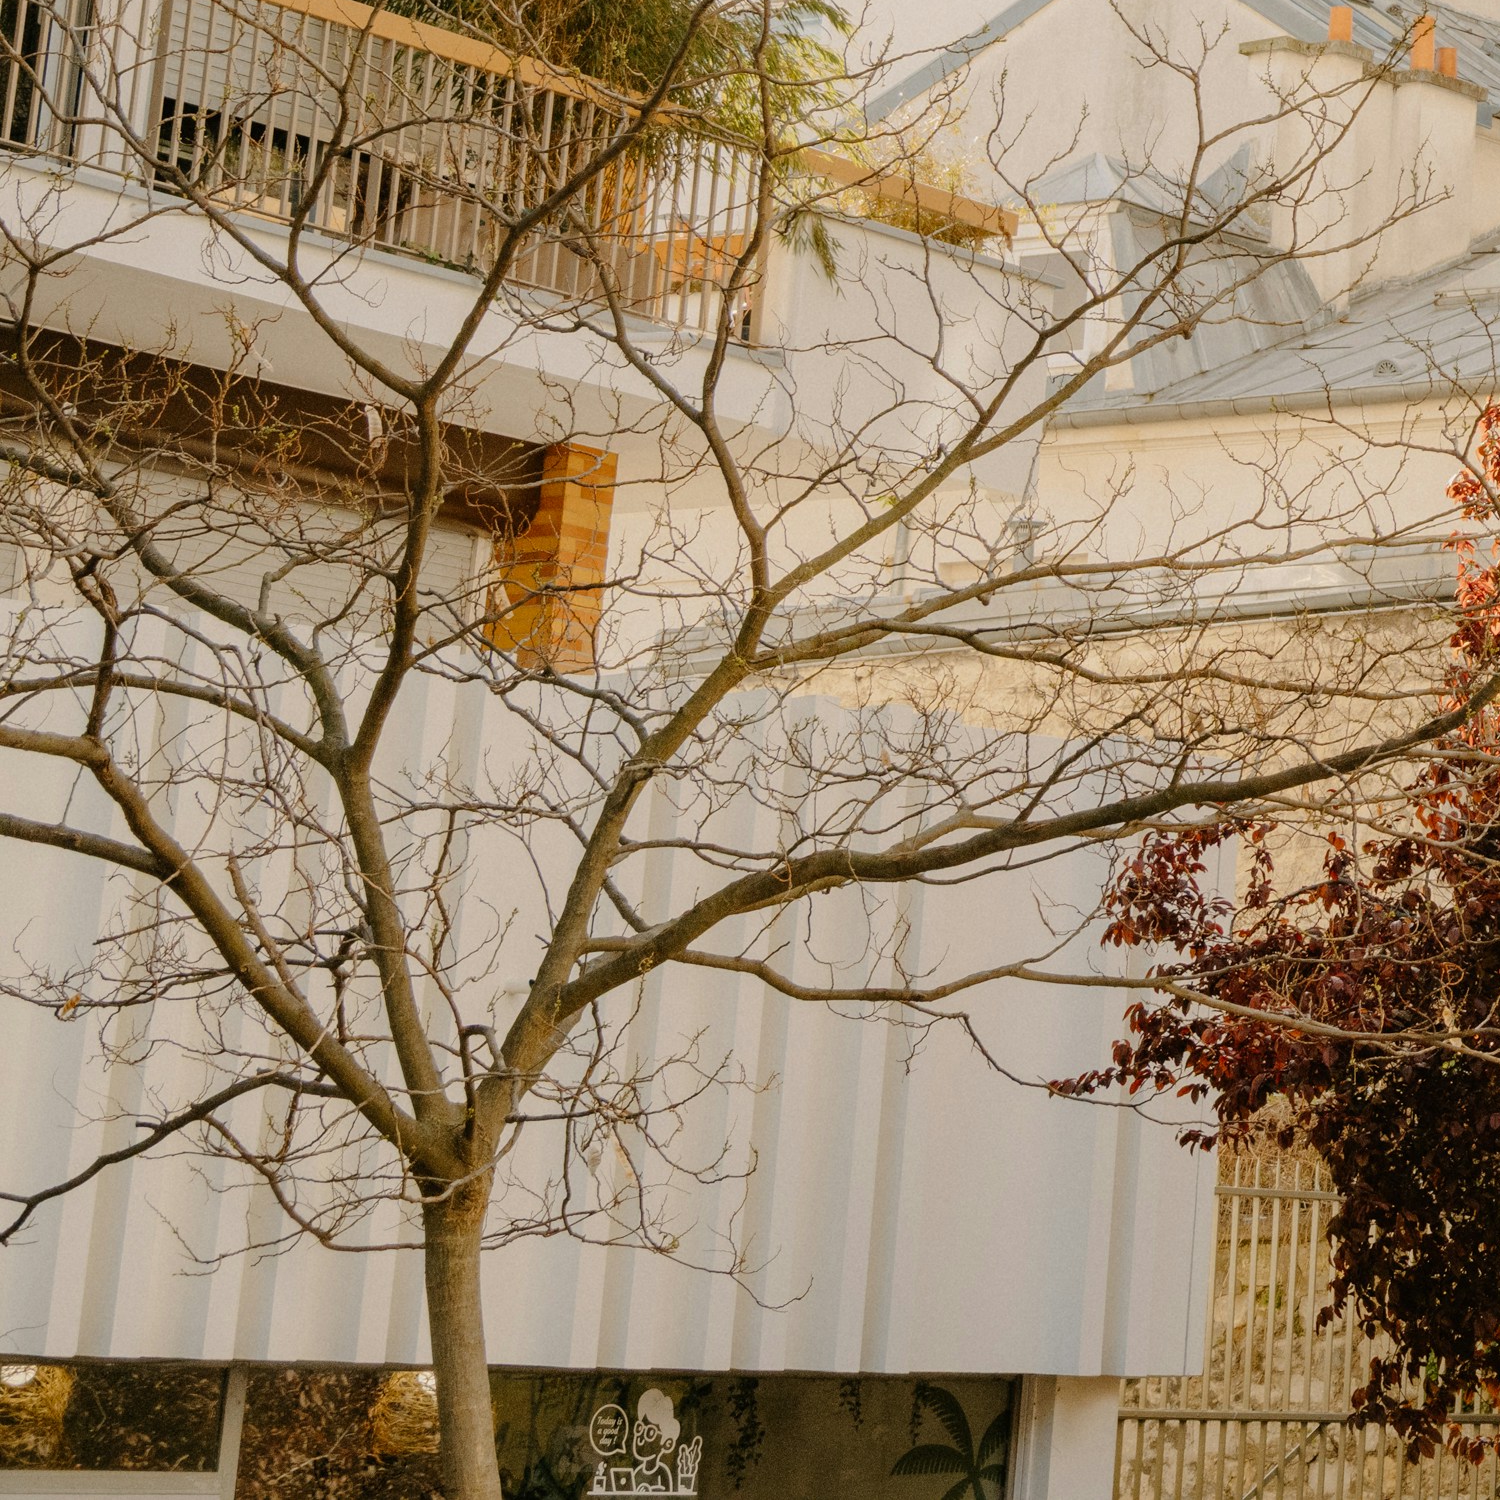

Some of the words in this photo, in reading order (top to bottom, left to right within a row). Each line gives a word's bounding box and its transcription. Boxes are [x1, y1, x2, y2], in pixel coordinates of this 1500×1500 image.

[597, 1416, 615, 1427] Today
[616, 1416, 623, 1425] is
[602, 1425, 619, 1438] good
